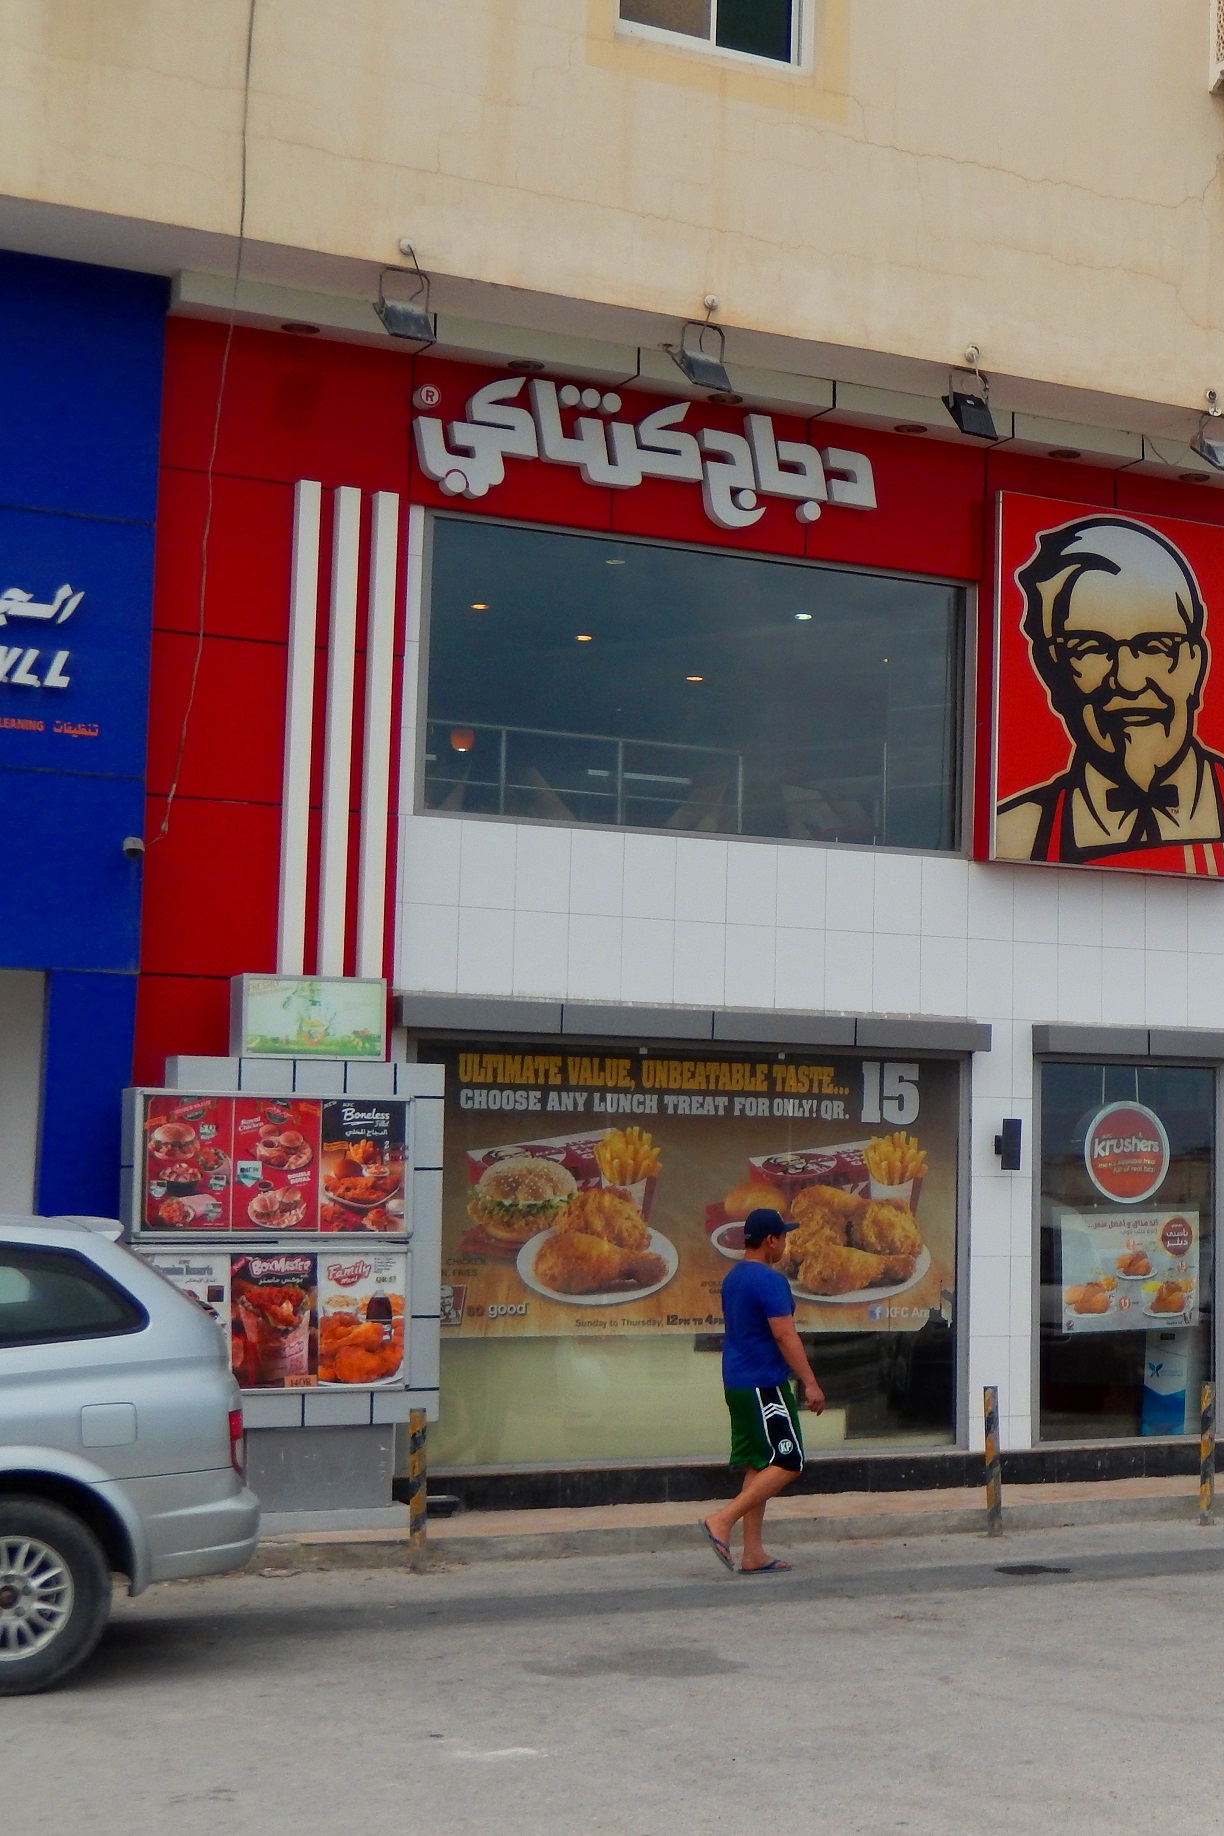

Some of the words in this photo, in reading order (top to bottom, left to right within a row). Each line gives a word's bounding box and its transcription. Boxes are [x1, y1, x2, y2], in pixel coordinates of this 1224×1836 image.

[413, 376, 704, 499] كنتاكي
[699, 413, 878, 530] دجاج
[0, 717, 45, 732] LEANING
[459, 1053, 562, 1085] ULTIMATE
[567, 1056, 636, 1091] VALUE,
[642, 1060, 769, 1093] UNBEATABLE
[773, 1064, 850, 1096] TASTE...
[460, 1088, 542, 1111] CHOOSE
[546, 1091, 588, 1112] ANY
[593, 1093, 659, 1114] LUNCH
[664, 1095, 728, 1116] TREAT
[734, 1096, 770, 1117] FOR
[773, 1097, 817, 1119] ONLY!
[820, 1100, 850, 1121] QR.
[861, 1061, 920, 1126] 15
[341, 1108, 390, 1121] Boneless
[1093, 1135, 1160, 1159] krushers
[326, 1260, 371, 1281] Family
[488, 1302, 528, 1319] good
[885, 1306, 909, 1318] KFC
[575, 1318, 606, 1328] Sunday
[609, 1317, 619, 1326] to
